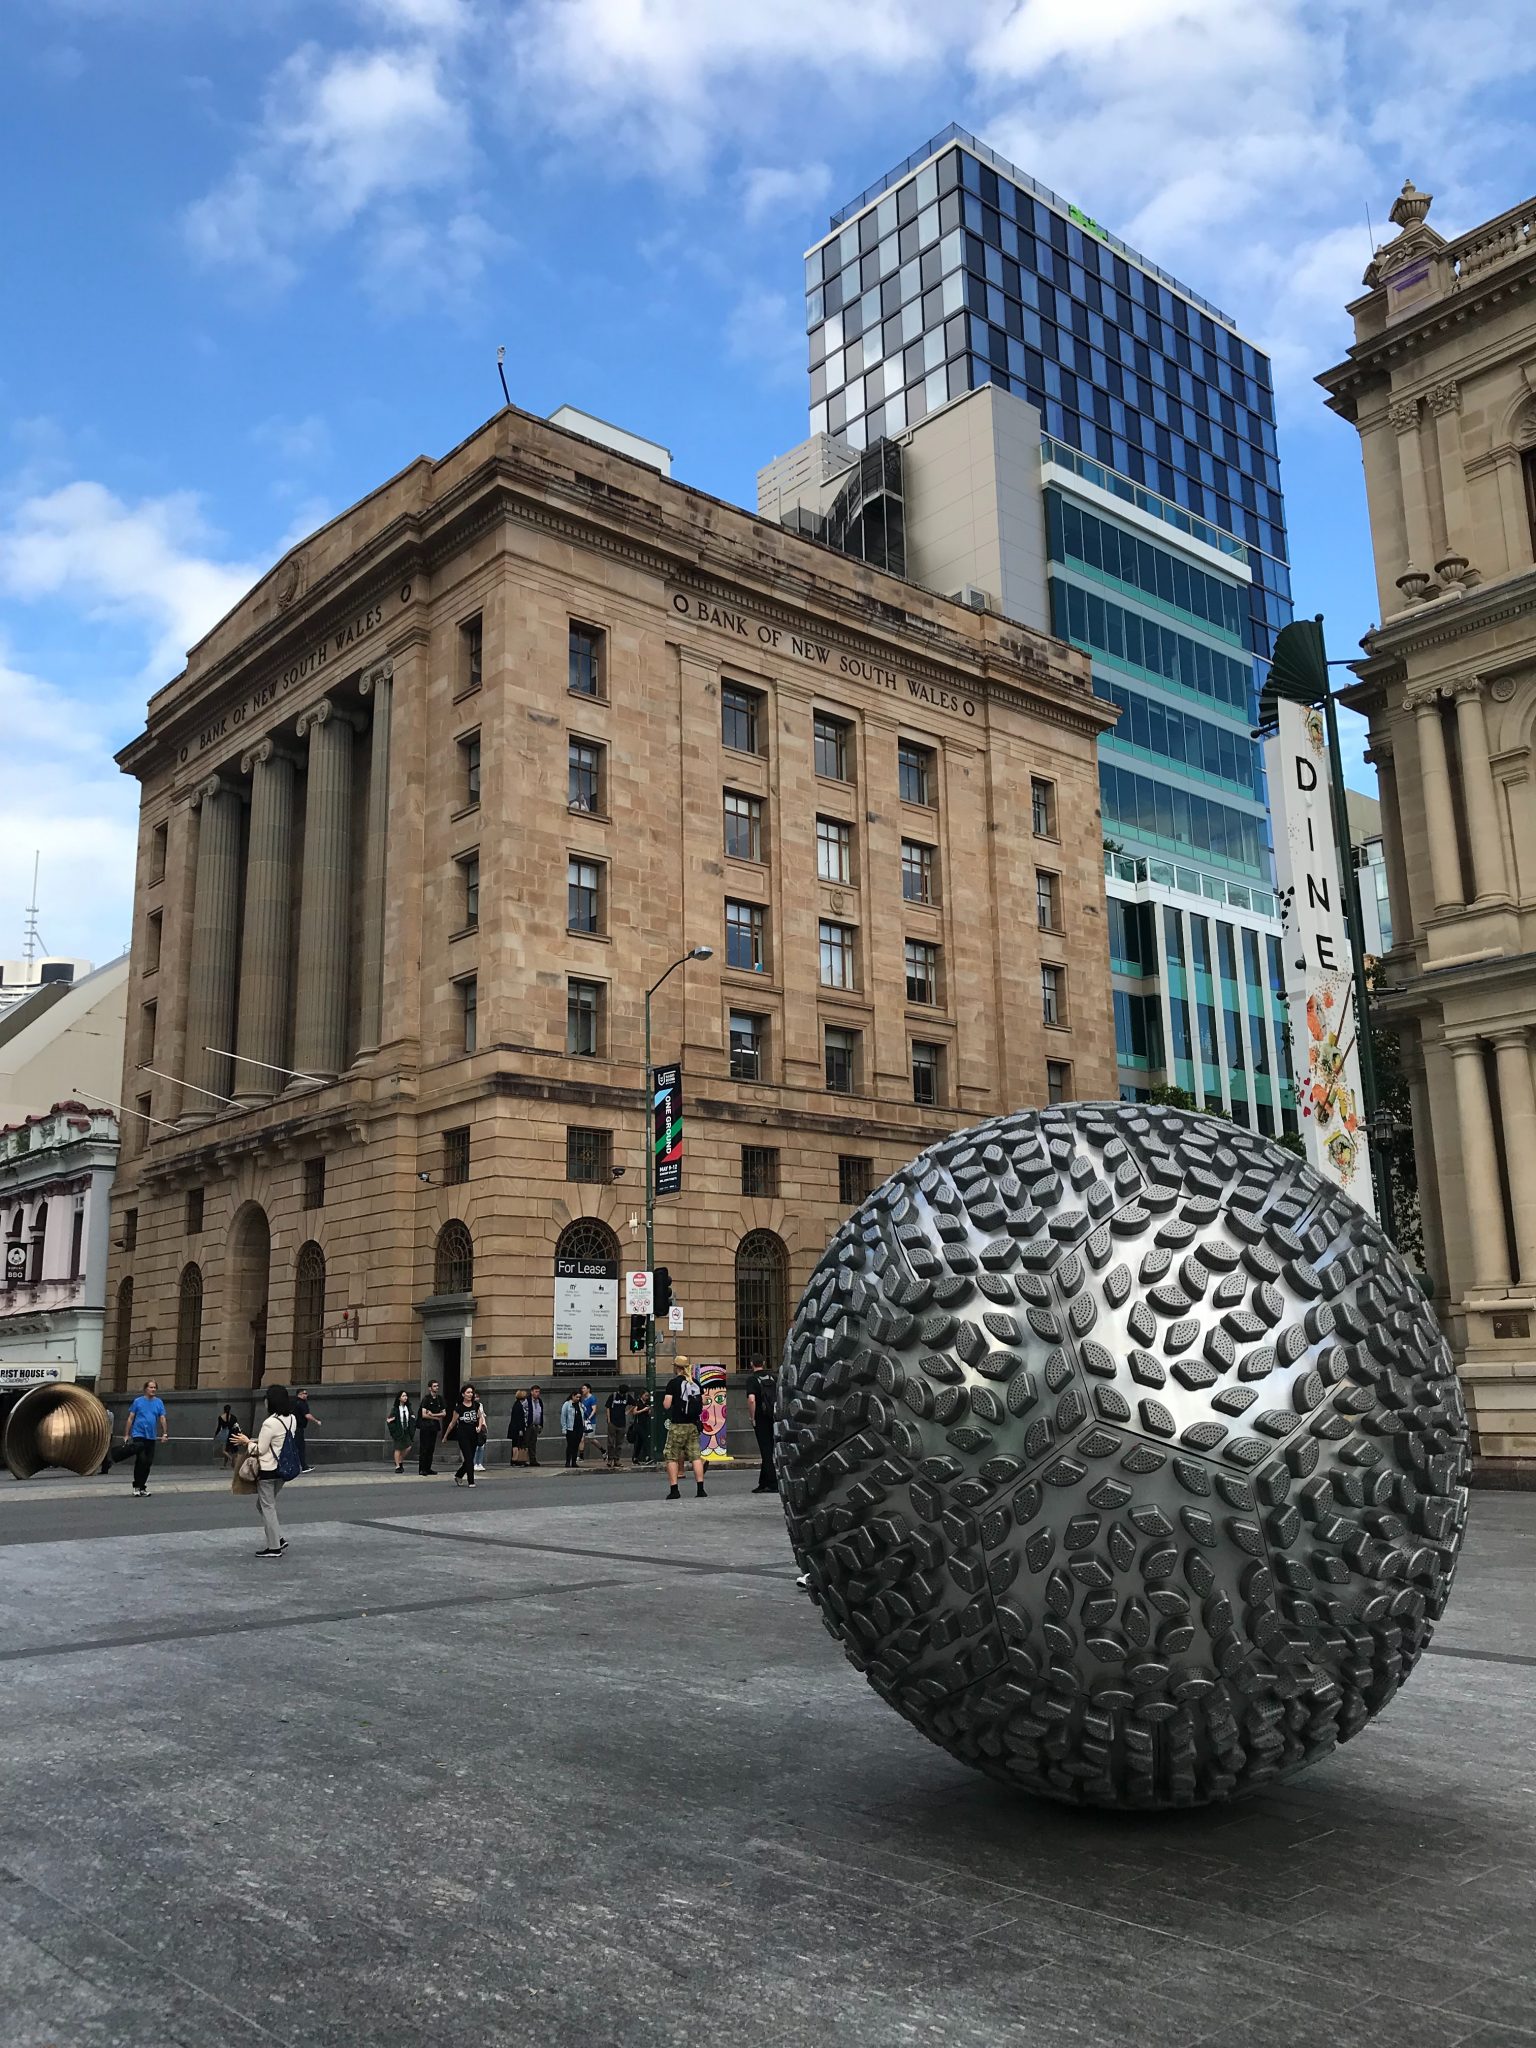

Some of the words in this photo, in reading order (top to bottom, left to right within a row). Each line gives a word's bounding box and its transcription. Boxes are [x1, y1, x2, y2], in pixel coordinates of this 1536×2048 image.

[200, 717, 227, 750] BANK
[233, 702, 248, 724] OF
[253, 680, 277, 712] NEW
[283, 644, 327, 689] SOUTH
[335, 605, 382, 651] WALES
[698, 601, 748, 636] BANK
[757, 626, 782, 647] OF
[791, 637, 830, 664] NEW
[839, 656, 897, 690] SOUTH
[906, 679, 958, 711] WALES
[1295, 756, 1338, 971] DINE
[558, 1260, 575, 1273] For
[577, 1261, 606, 1275] Lease
[19, 1369, 45, 1378] HOUSE
